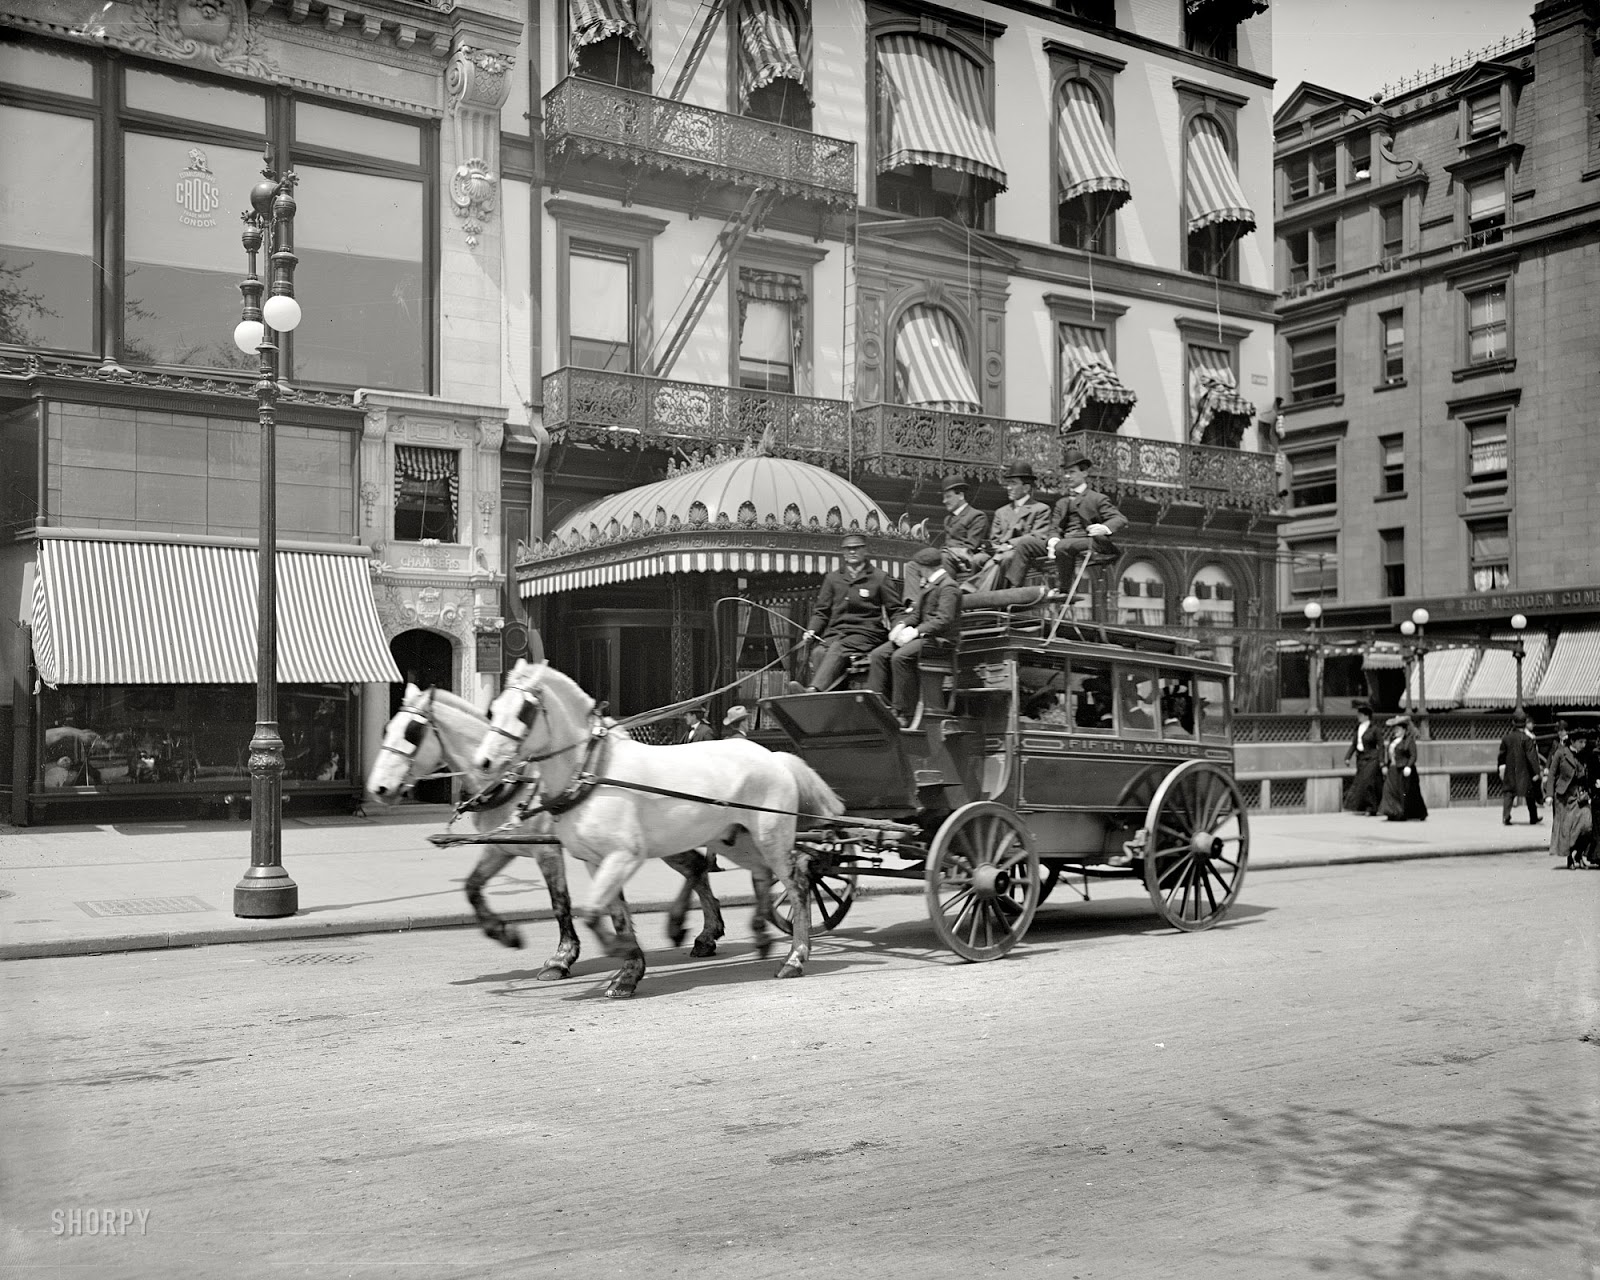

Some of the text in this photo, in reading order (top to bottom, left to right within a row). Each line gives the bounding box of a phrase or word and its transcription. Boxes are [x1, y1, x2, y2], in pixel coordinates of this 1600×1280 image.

[176, 178, 219, 213] CROSS
[179, 215, 217, 228] LONDON
[410, 547, 450, 559] CROSS
[400, 557, 460, 569] CHAMBERS
[1461, 598, 1487, 611] THE
[1491, 593, 1554, 609] MERIDEN
[1068, 739, 1199, 756] FIFTH AVENUE
